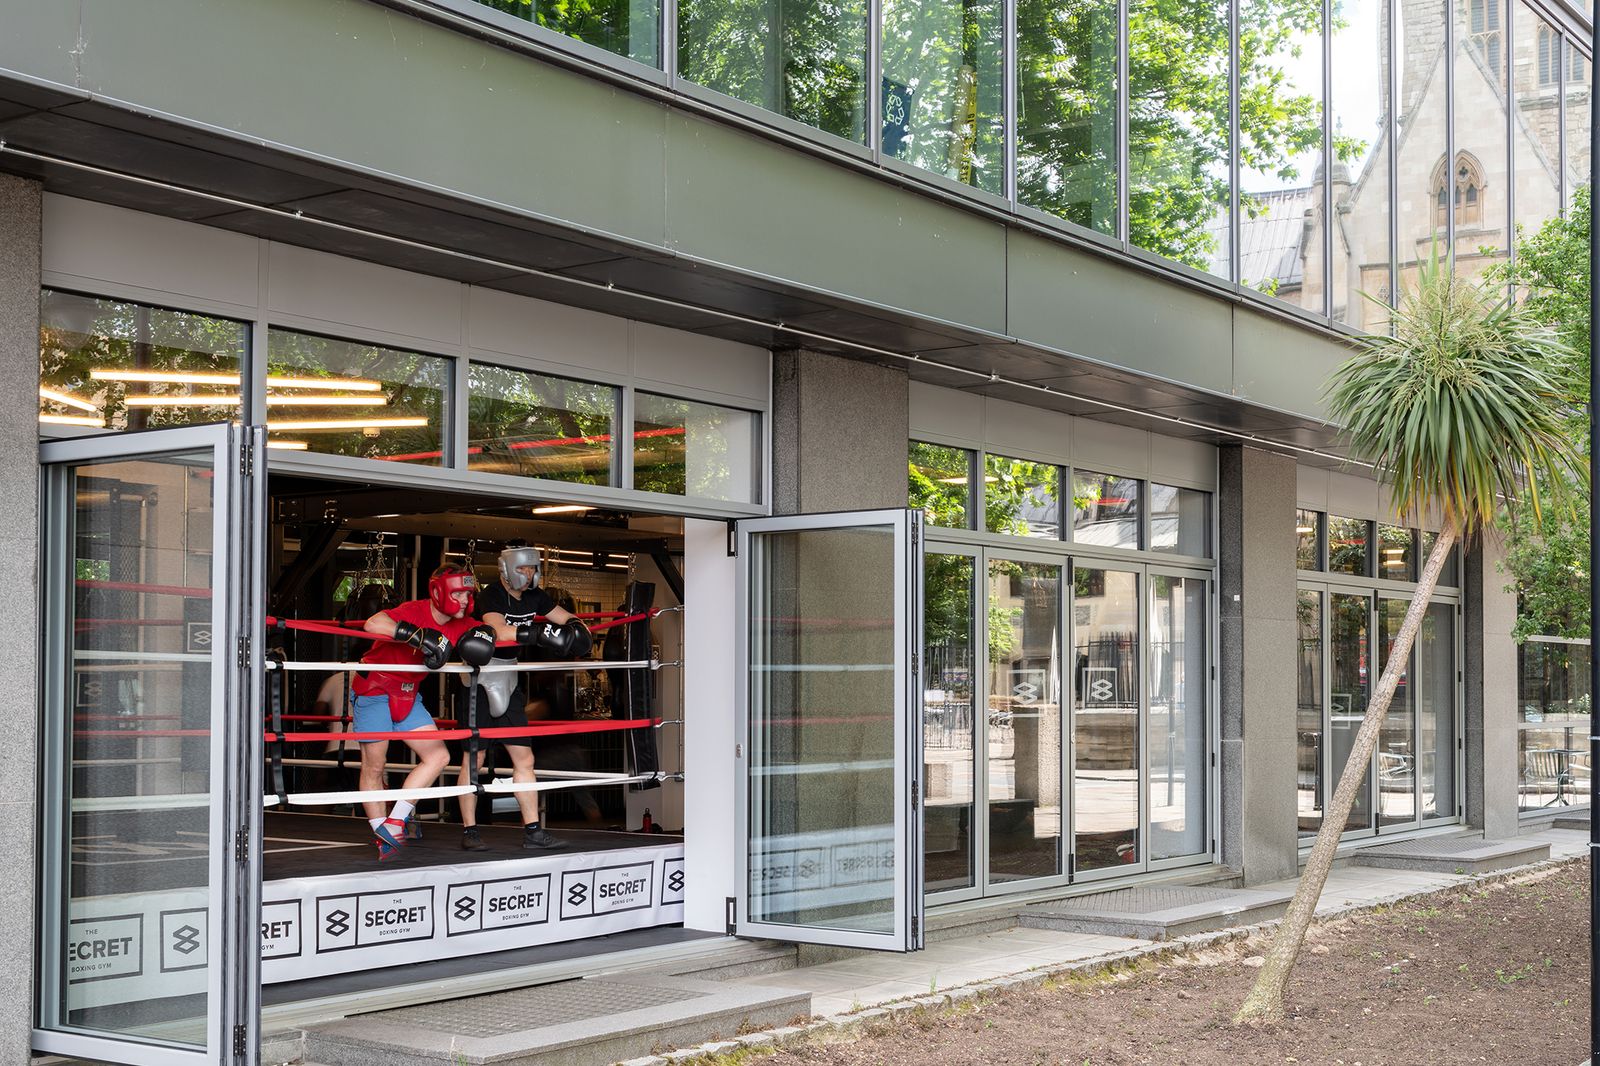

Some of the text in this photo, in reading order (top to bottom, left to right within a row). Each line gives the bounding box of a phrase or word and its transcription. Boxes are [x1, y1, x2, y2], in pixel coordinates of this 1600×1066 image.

[599, 878, 646, 898] SECRET
[488, 892, 543, 912] SECRET
[364, 905, 427, 927] SECRET
[85, 928, 98, 936] THE
[71, 964, 96, 973] BOXING
